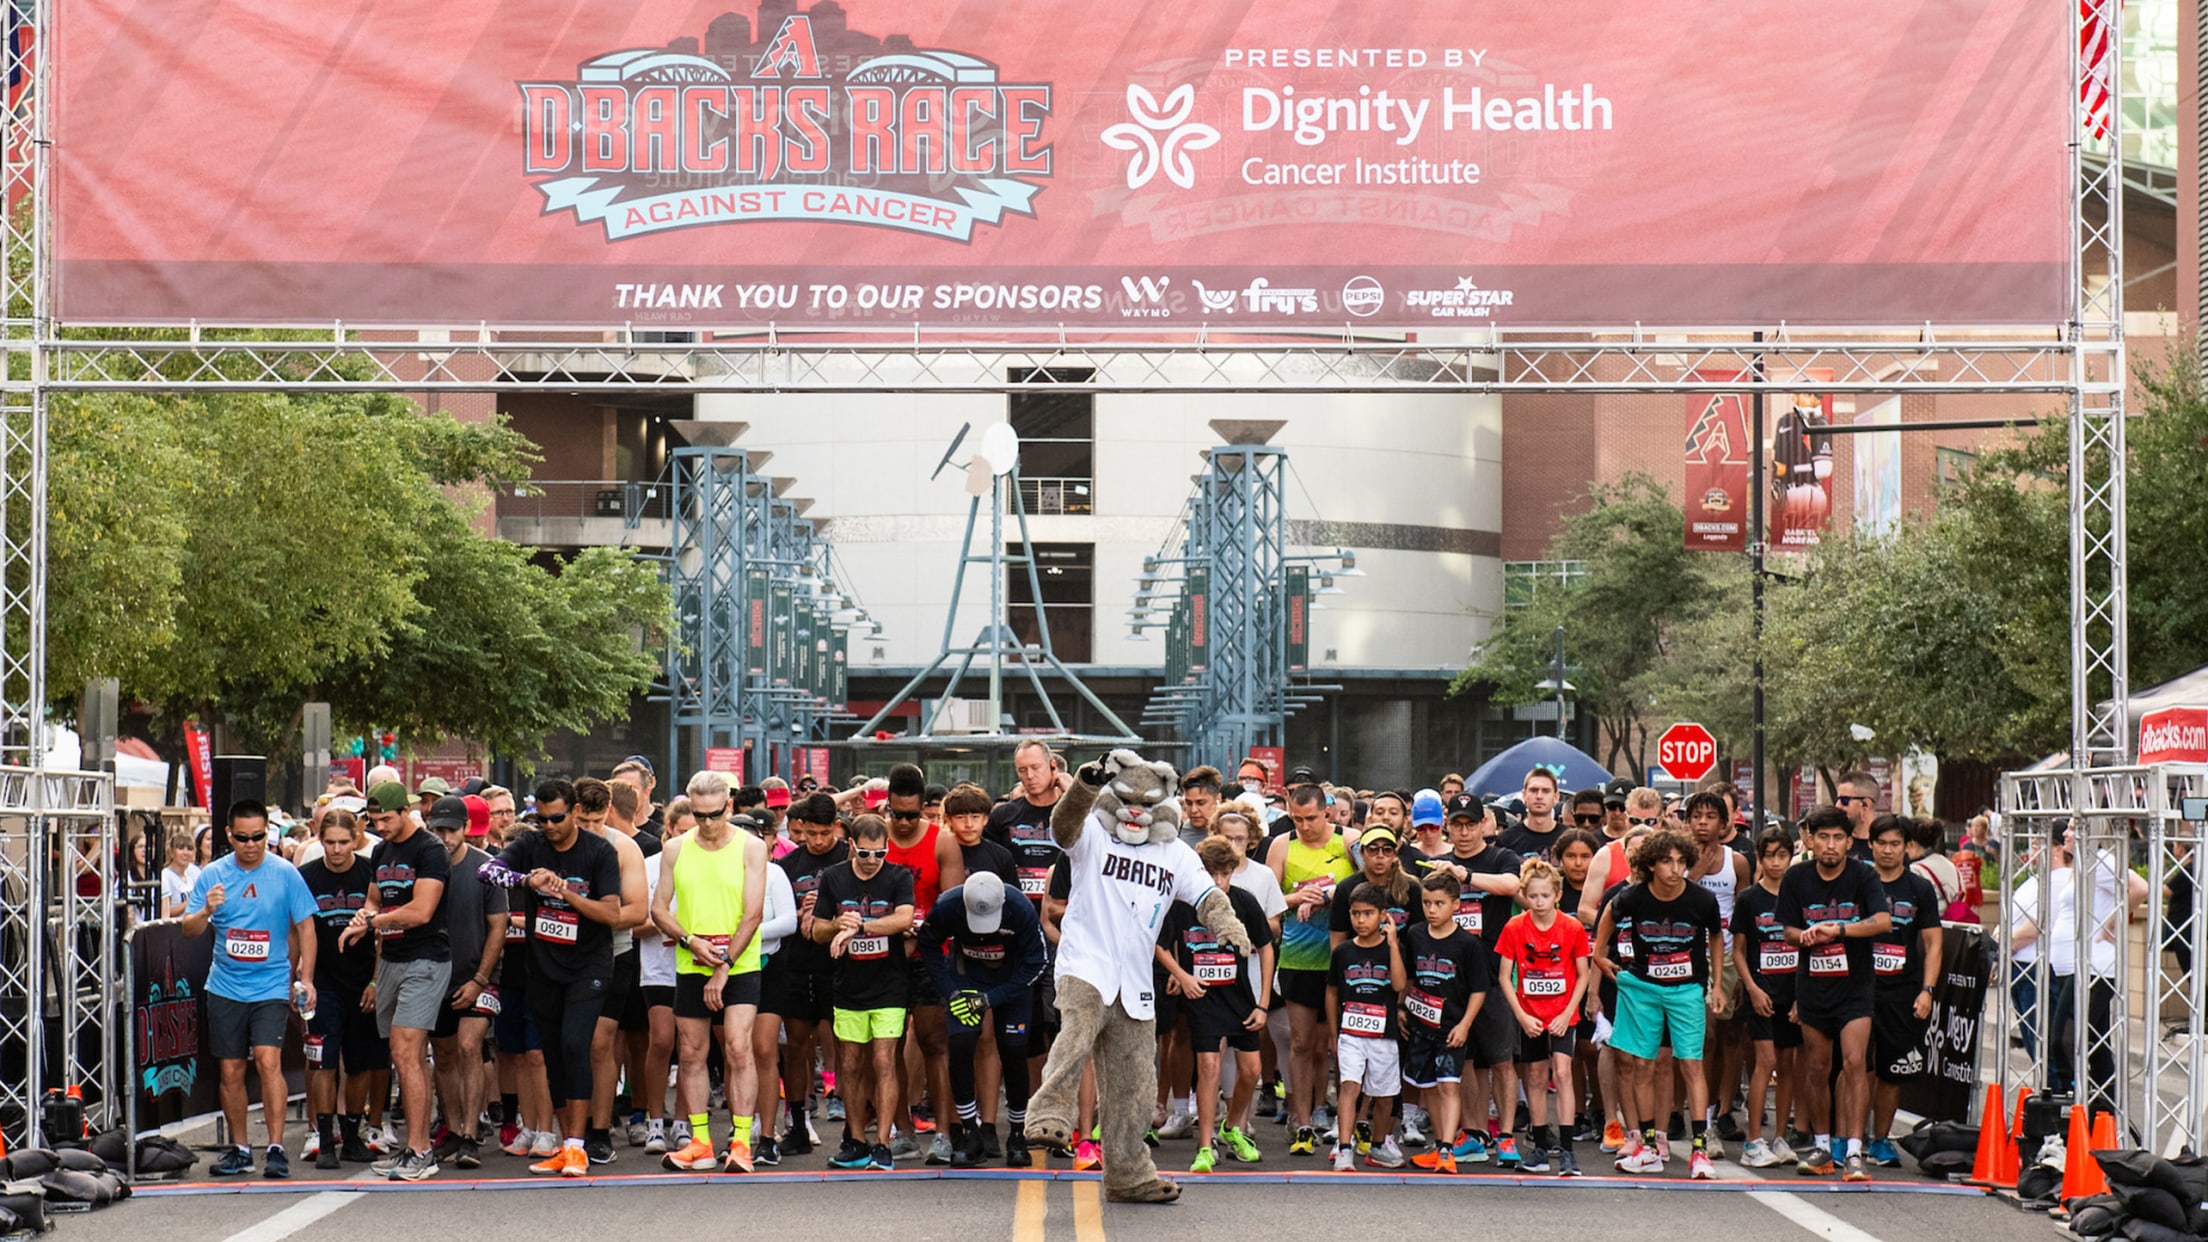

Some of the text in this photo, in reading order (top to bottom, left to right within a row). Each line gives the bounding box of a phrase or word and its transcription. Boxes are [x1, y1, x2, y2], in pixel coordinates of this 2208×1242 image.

[1224, 49, 1488, 68] PRESENTED BY
[1242, 84, 1430, 146] Dignity
[1443, 83, 1613, 132] Health
[844, 85, 1050, 175] RACE
[1241, 156, 1481, 185] Cancer Institute
[624, 191, 957, 230] AGAINST CANCER
[615, 284, 1104, 310] THANK YOU TO OUR SPONSORS
[1345, 291, 1382, 301] PEPSI
[1406, 290, 1514, 306] SUPER STAR
[1121, 308, 1171, 318] WAYMO
[1432, 307, 1491, 317] CAR WASH
[2142, 719, 2206, 755] dbacks.com
[197, 735, 213, 780] FIRST
[1662, 741, 1713, 763] STOP
[1101, 852, 1175, 897] DBACKS
[1149, 903, 1162, 929] 1
[540, 921, 570, 937] 0921
[231, 941, 265, 957] 0288
[851, 940, 881, 953] 0981
[1765, 954, 1795, 967] 0908
[1811, 958, 1842, 970] 0154
[1873, 957, 1899, 969] 907
[1199, 967, 1231, 978] 0816
[1654, 965, 1687, 977] 0245
[1528, 981, 1561, 993] 0592
[1408, 1001, 1436, 1020] 0828
[1347, 1015, 1380, 1030] 0829
